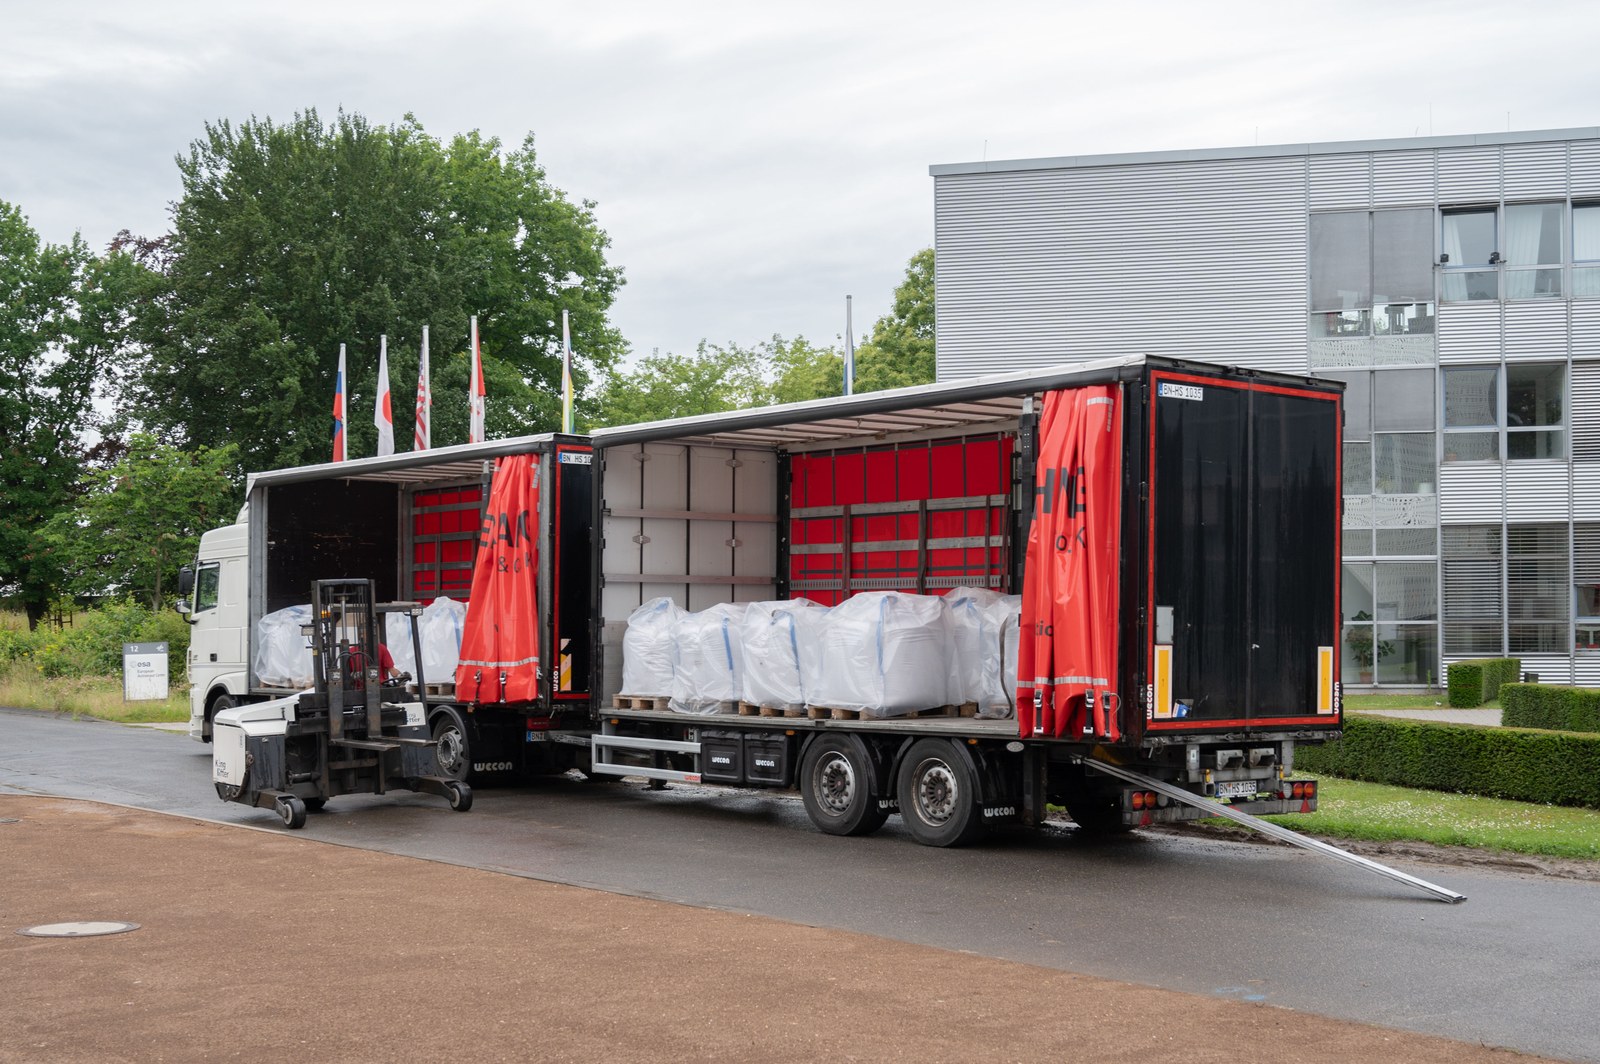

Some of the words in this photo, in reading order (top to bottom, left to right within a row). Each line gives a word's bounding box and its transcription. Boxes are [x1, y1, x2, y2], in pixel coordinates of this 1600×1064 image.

[1185, 387, 1202, 399] 1035
[130, 645, 139, 653] 12
[711, 756, 731, 764] wecon
[755, 759, 775, 767] wecon
[473, 761, 513, 772] wecon
[1220, 783, 1228, 794] BN
[1231, 782, 1240, 794] HS
[1241, 781, 1256, 793] 1035
[983, 806, 1016, 818] wecon
